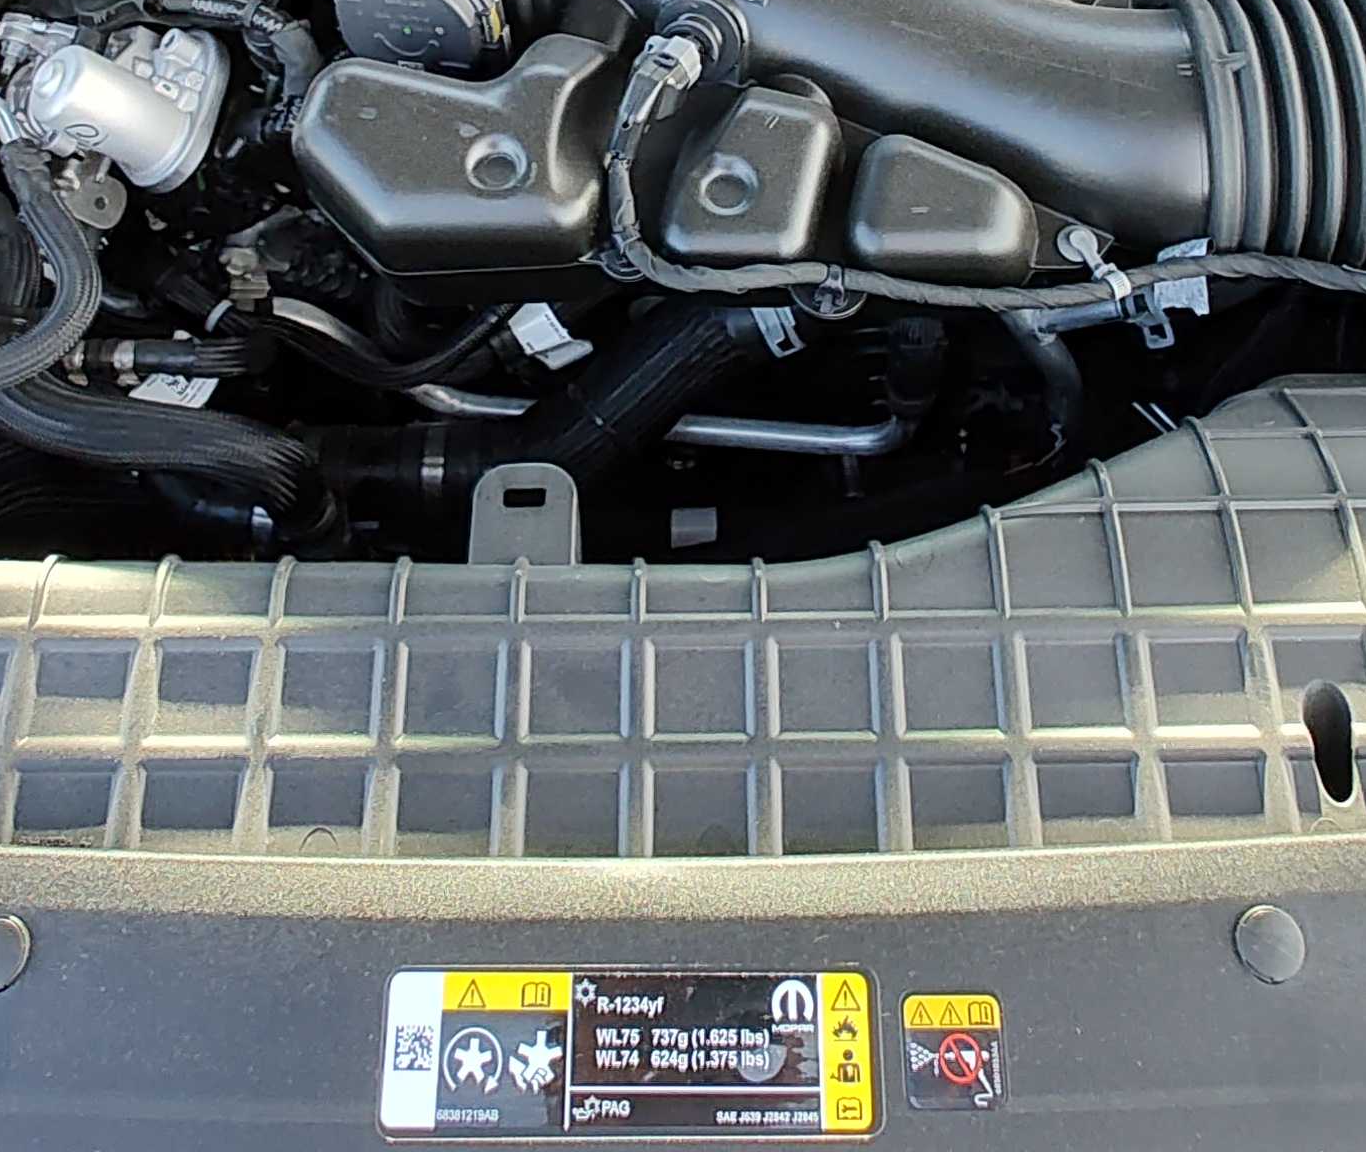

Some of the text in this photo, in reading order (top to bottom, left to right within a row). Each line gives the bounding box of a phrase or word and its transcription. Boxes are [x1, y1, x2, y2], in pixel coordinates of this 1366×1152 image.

[596, 996, 665, 1019] R-1234yf
[771, 1023, 815, 1034] MOPAR
[595, 1028, 771, 1051] WL75 737g (1.625 lbs)
[595, 1050, 771, 1072] WL74 624g (1.375 lbs)
[601, 1100, 632, 1117] PAG
[715, 1110, 737, 1125] SAE
